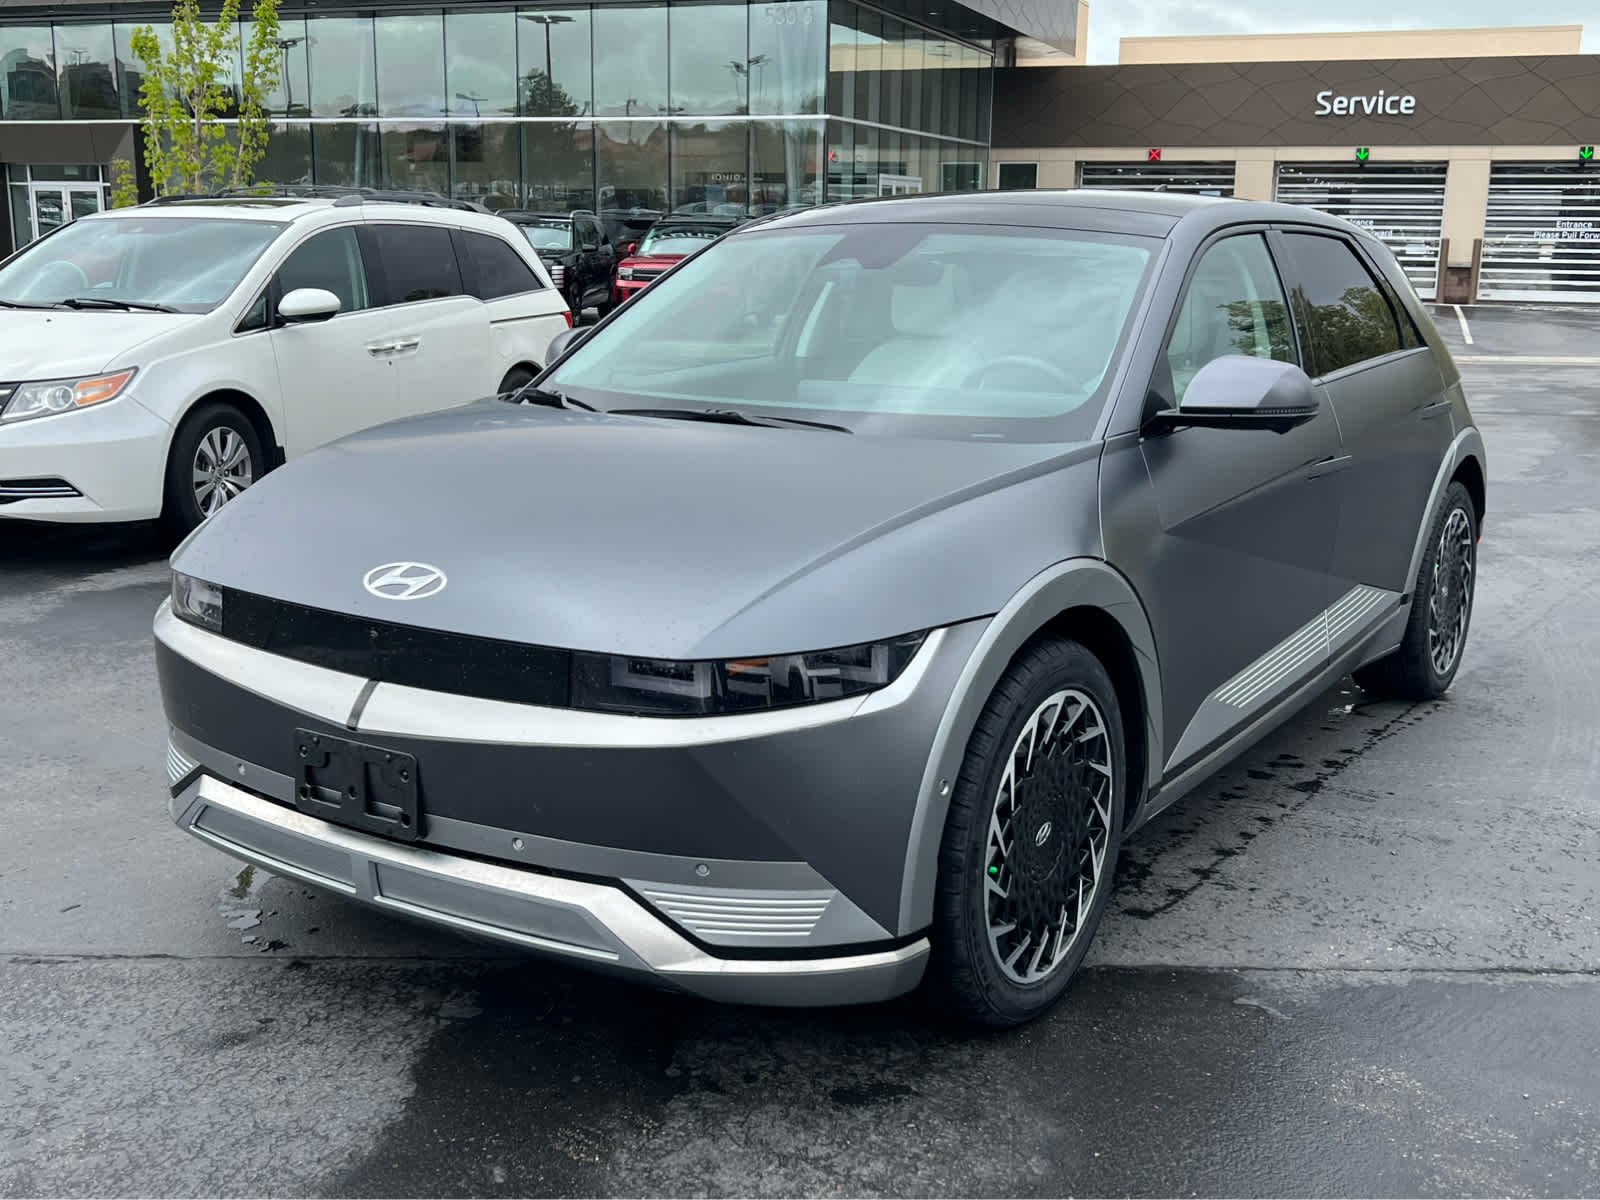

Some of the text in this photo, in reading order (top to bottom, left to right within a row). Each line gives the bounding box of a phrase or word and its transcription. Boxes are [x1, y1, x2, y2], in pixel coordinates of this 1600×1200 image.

[1314, 89, 1416, 116] Service
[1555, 219, 1593, 229] Entrance
[1561, 230, 1578, 239] Pull
